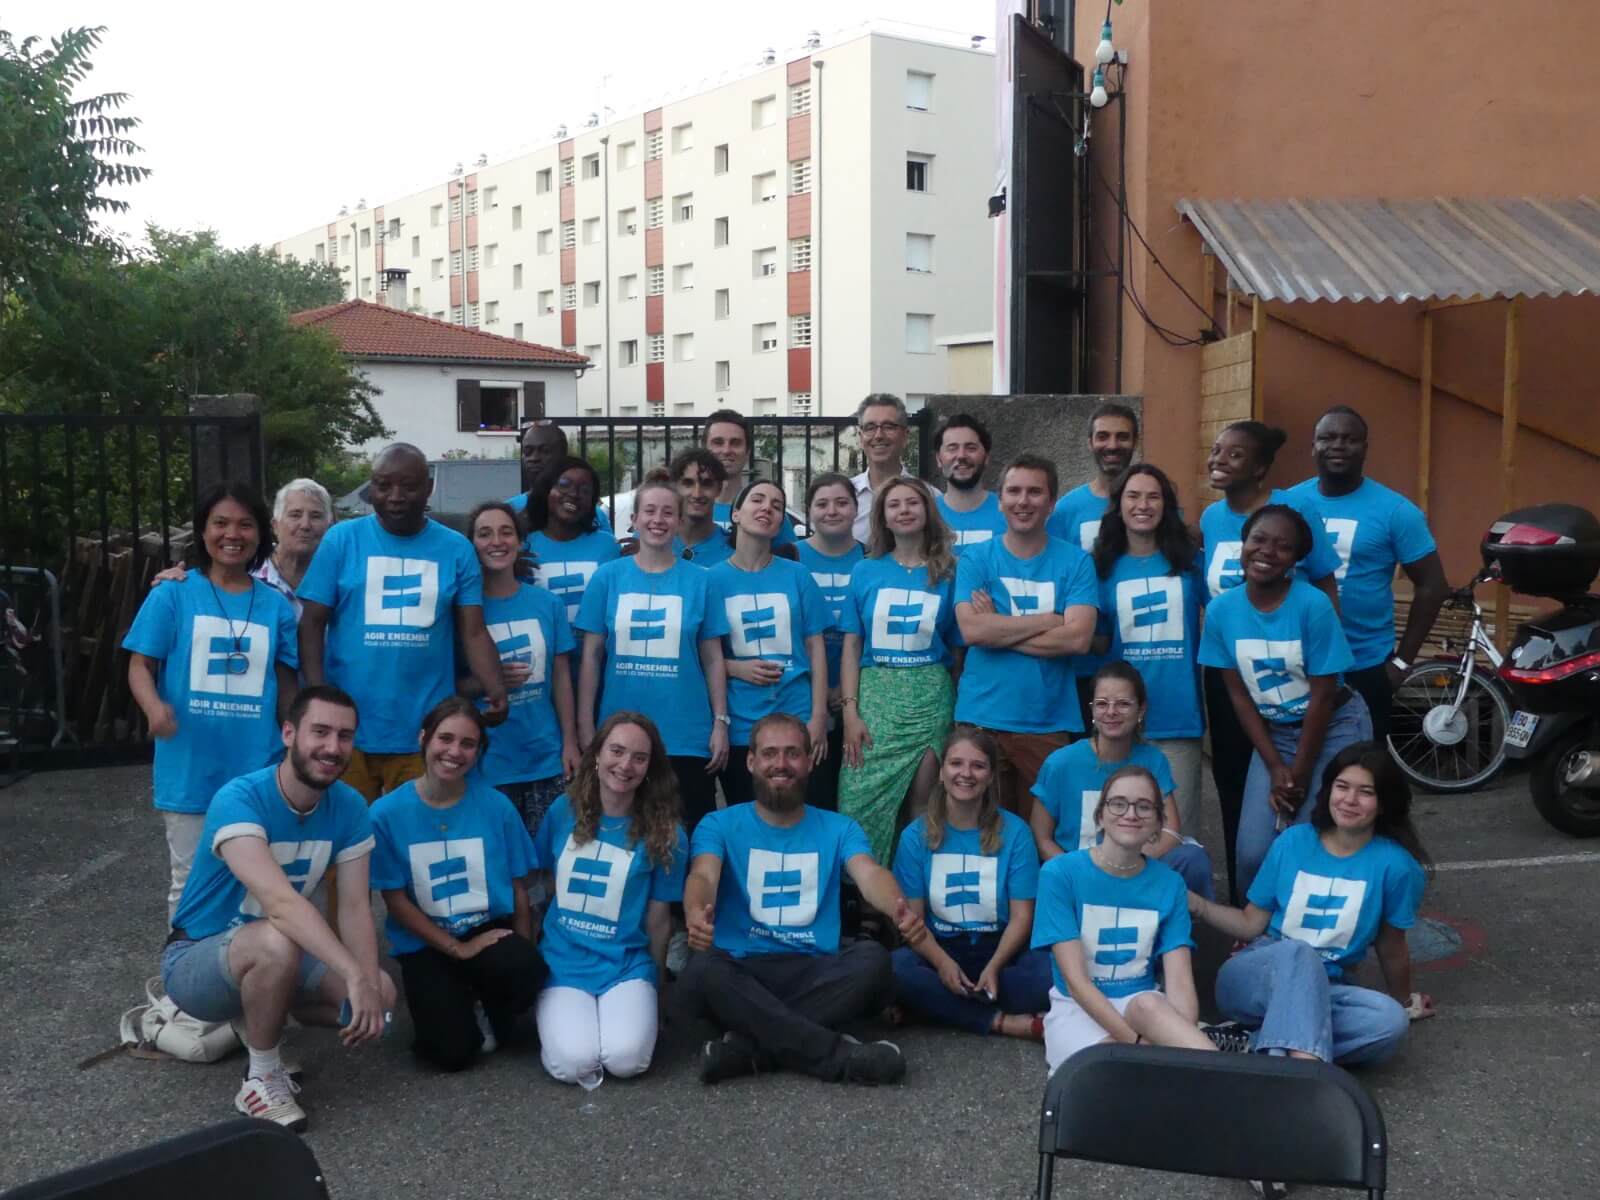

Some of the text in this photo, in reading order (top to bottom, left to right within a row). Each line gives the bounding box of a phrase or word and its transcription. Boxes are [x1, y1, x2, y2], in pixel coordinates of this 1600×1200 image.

[364, 632, 385, 641] AGIR
[1142, 647, 1184, 656] ENSEMBLE
[616, 662, 678, 673] AGIR ENSEMBLE
[189, 698, 261, 713] AGIR ENSEMBLE
[568, 918, 617, 934] ENSEMBLE
